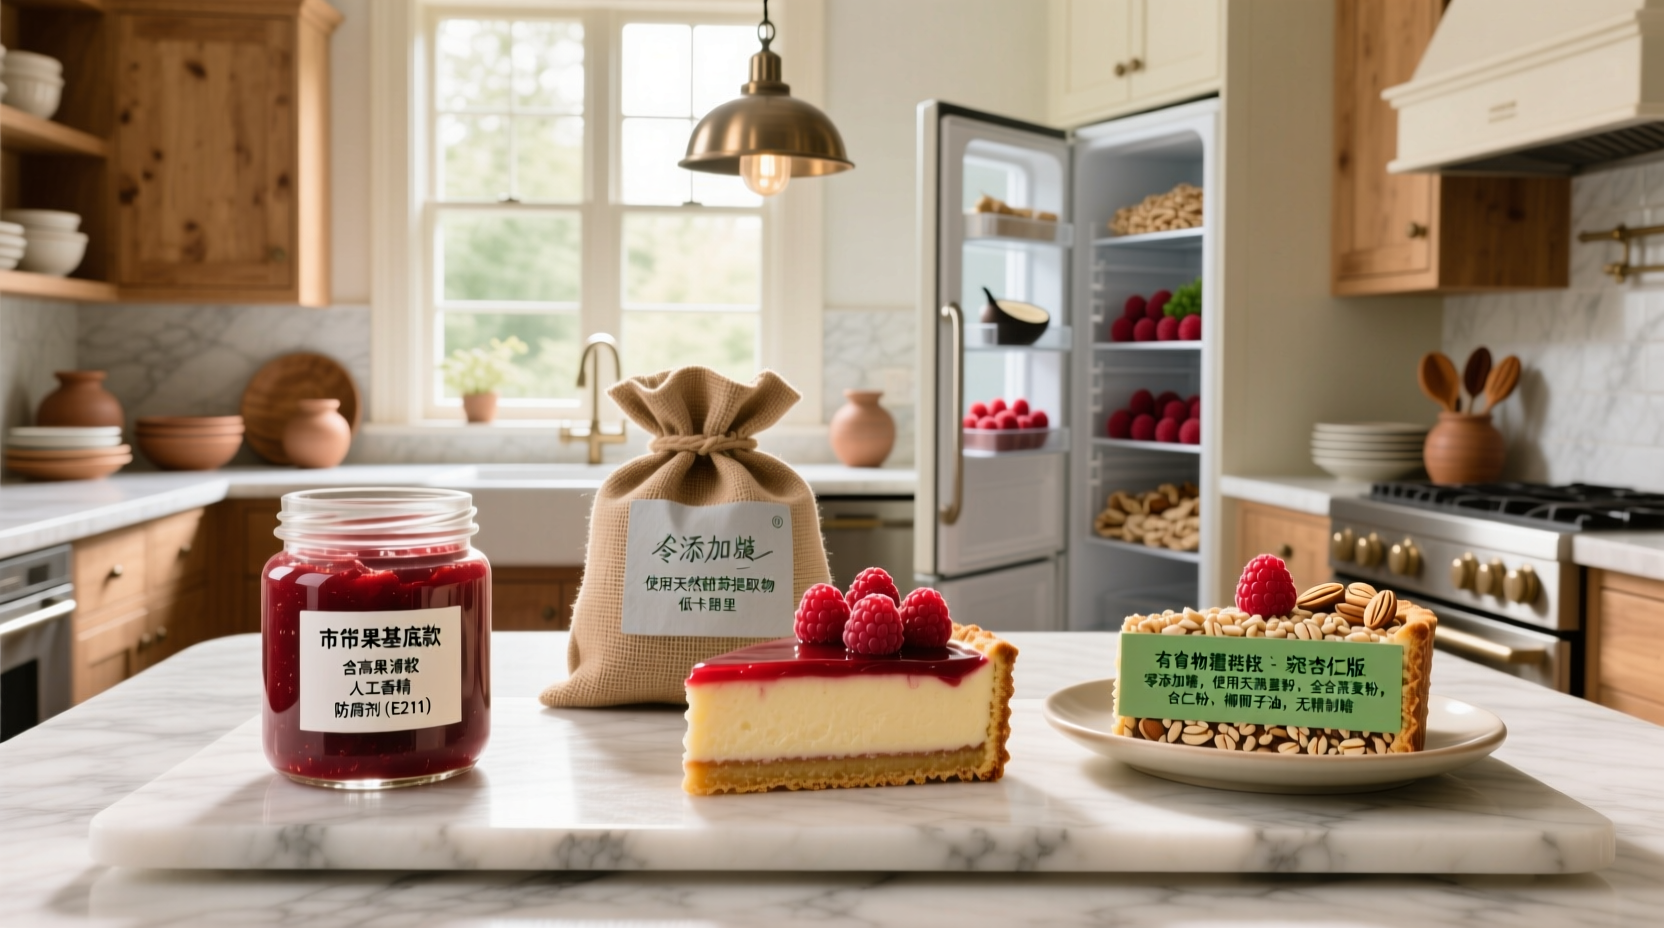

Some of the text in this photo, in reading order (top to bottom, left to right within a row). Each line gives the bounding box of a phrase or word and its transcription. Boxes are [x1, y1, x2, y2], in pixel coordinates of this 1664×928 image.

[349, 678, 411, 696] 人工香精
[385, 697, 432, 718] (E211)
